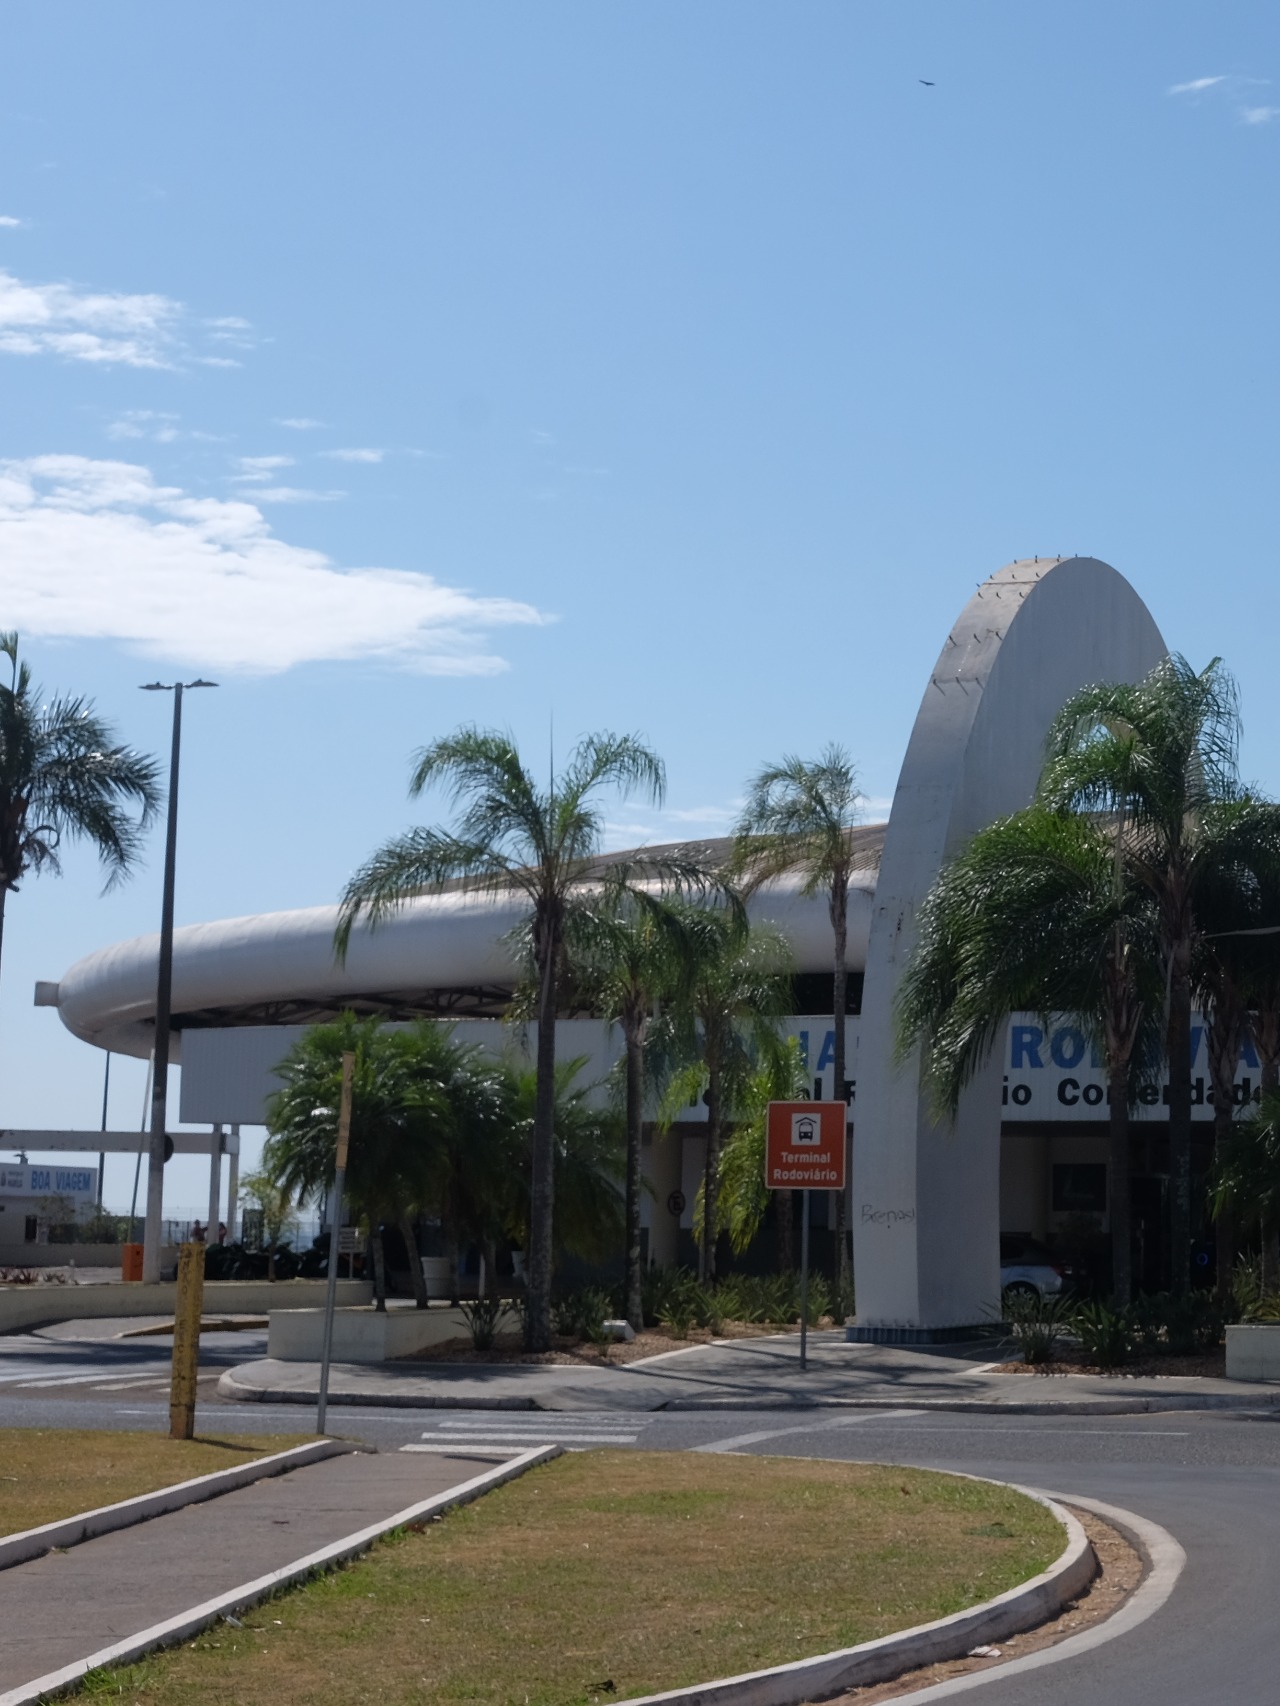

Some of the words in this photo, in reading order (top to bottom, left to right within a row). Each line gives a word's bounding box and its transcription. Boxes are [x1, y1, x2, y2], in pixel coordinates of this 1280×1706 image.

[780, 1152, 831, 1164] Terminal
[31, 1170, 50, 1190] BOA
[55, 1171, 91, 1191] VIAGEM
[773, 1168, 838, 1181] Rodoviário
